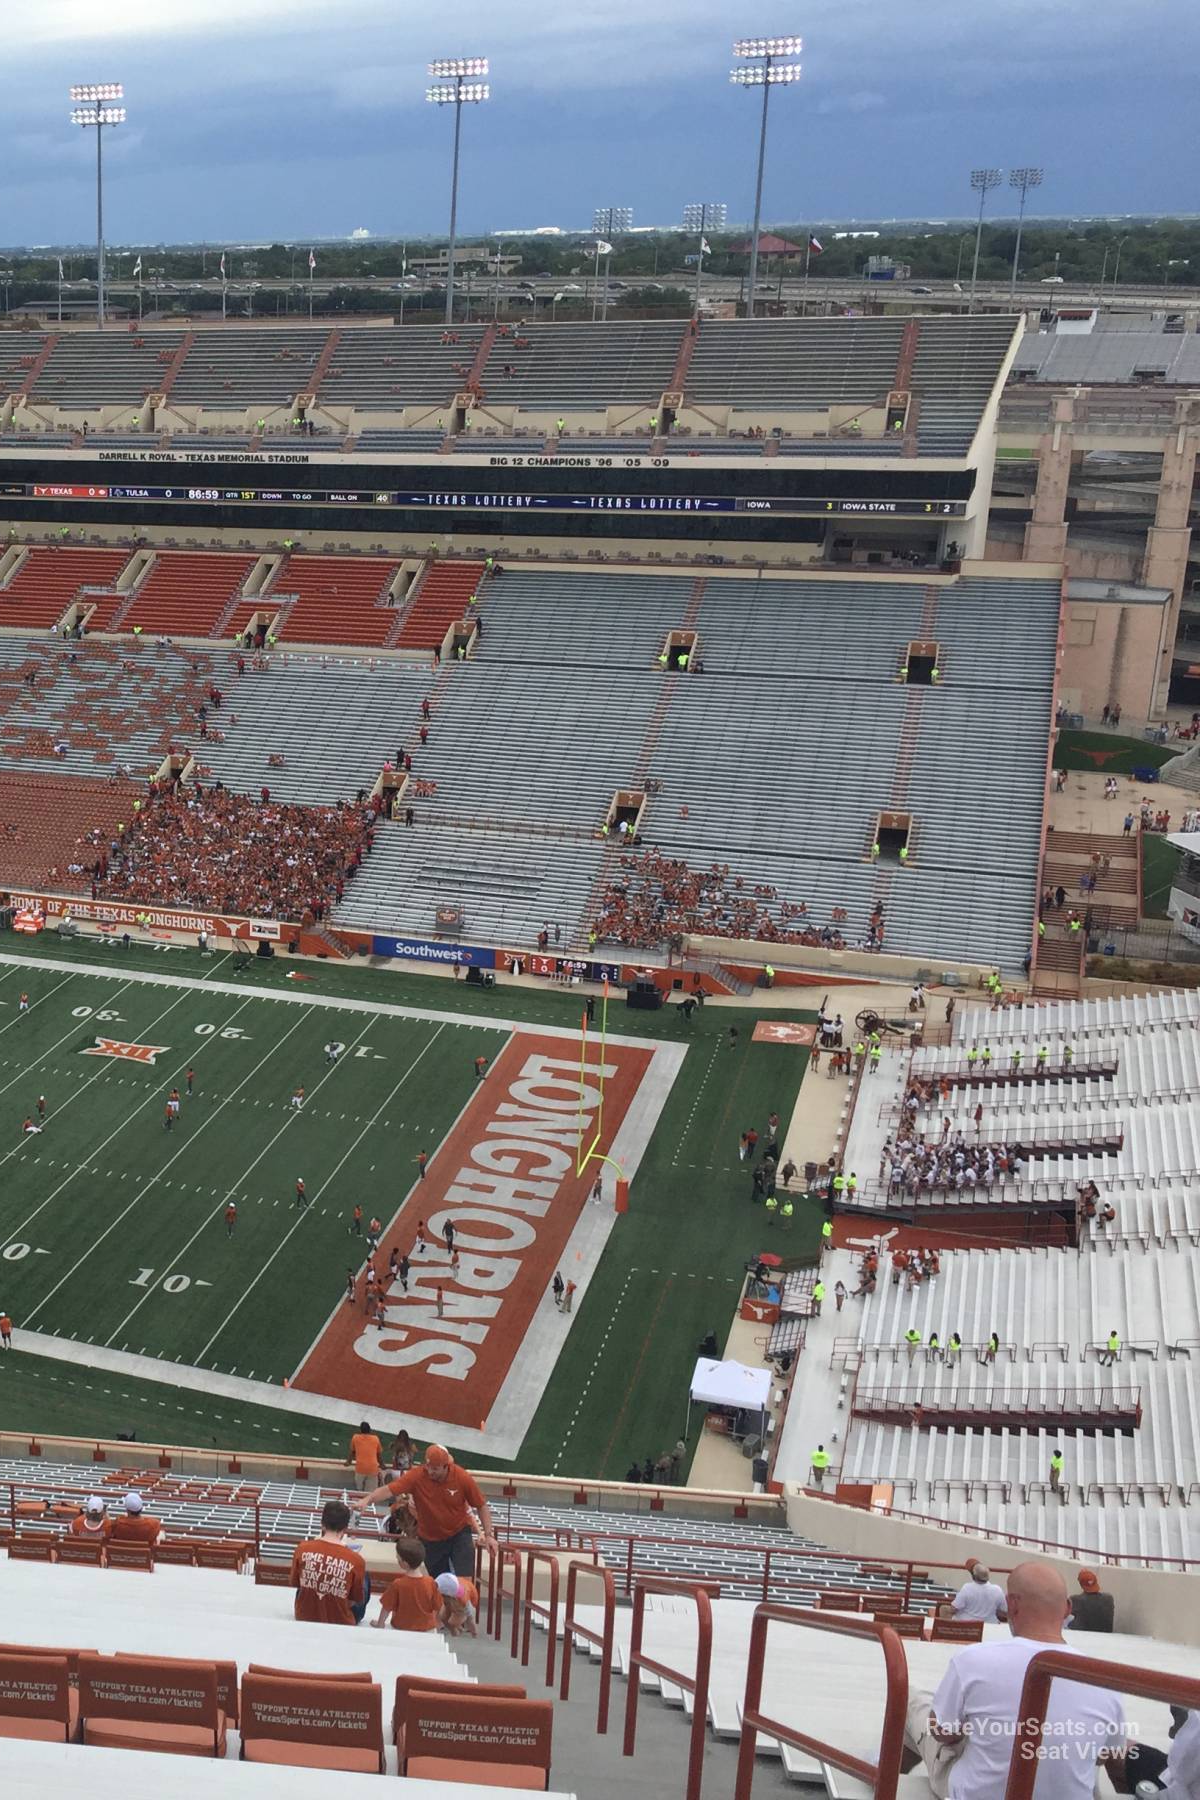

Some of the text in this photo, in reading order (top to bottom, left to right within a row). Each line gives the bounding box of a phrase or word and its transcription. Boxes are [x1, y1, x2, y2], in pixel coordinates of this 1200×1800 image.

[99, 452, 138, 460] DARRELL
[150, 453, 176, 461] ROYAL
[185, 454, 216, 462] TEXAS
[218, 454, 266, 462] MEMORIAL
[268, 455, 309, 463] STADIUM
[490, 458, 508, 466] BIG
[512, 458, 523, 466] 12
[527, 458, 591, 466] CHAMPIONS
[650, 459, 670, 467] '09
[50, 488, 95, 496] TEXAS 0
[126, 489, 172, 497] TULSA 0
[188, 490, 219, 499] 86:59
[240, 492, 256, 500] 1ST
[428, 494, 532, 506] TEXAS LOTTERY
[590, 497, 700, 510] TEXAS LOTTERY
[944, 504, 950, 512] 2
[10, 896, 42, 911] HOME
[47, 901, 62, 912] OF
[94, 906, 136, 922] TEXAS
[396, 942, 464, 961] Southwest
[353, 1053, 619, 1381] LONGHORNS
[128, 1268, 190, 1293] 10
[302, 1552, 354, 1573] COME EARLY
[305, 1562, 346, 1580] BE LOUD
[302, 1569, 347, 1590] STAY LATE
[12, 1682, 58, 1692] ATHLETICS
[90, 1680, 128, 1691] SUPPORT
[130, 1684, 157, 1694] TEXAS
[158, 1687, 206, 1698] ATHLETICS
[93, 1689, 202, 1708] TexasSports.com/tickets
[252, 1702, 370, 1720] SUPPORT TEXAS ATHLETICS
[255, 1712, 367, 1730] TexasSports.com/tickets
[418, 1719, 540, 1736] SUPPORT TEXAS ATHLETICS
[421, 1728, 537, 1746] TexasSports.com/tickets
